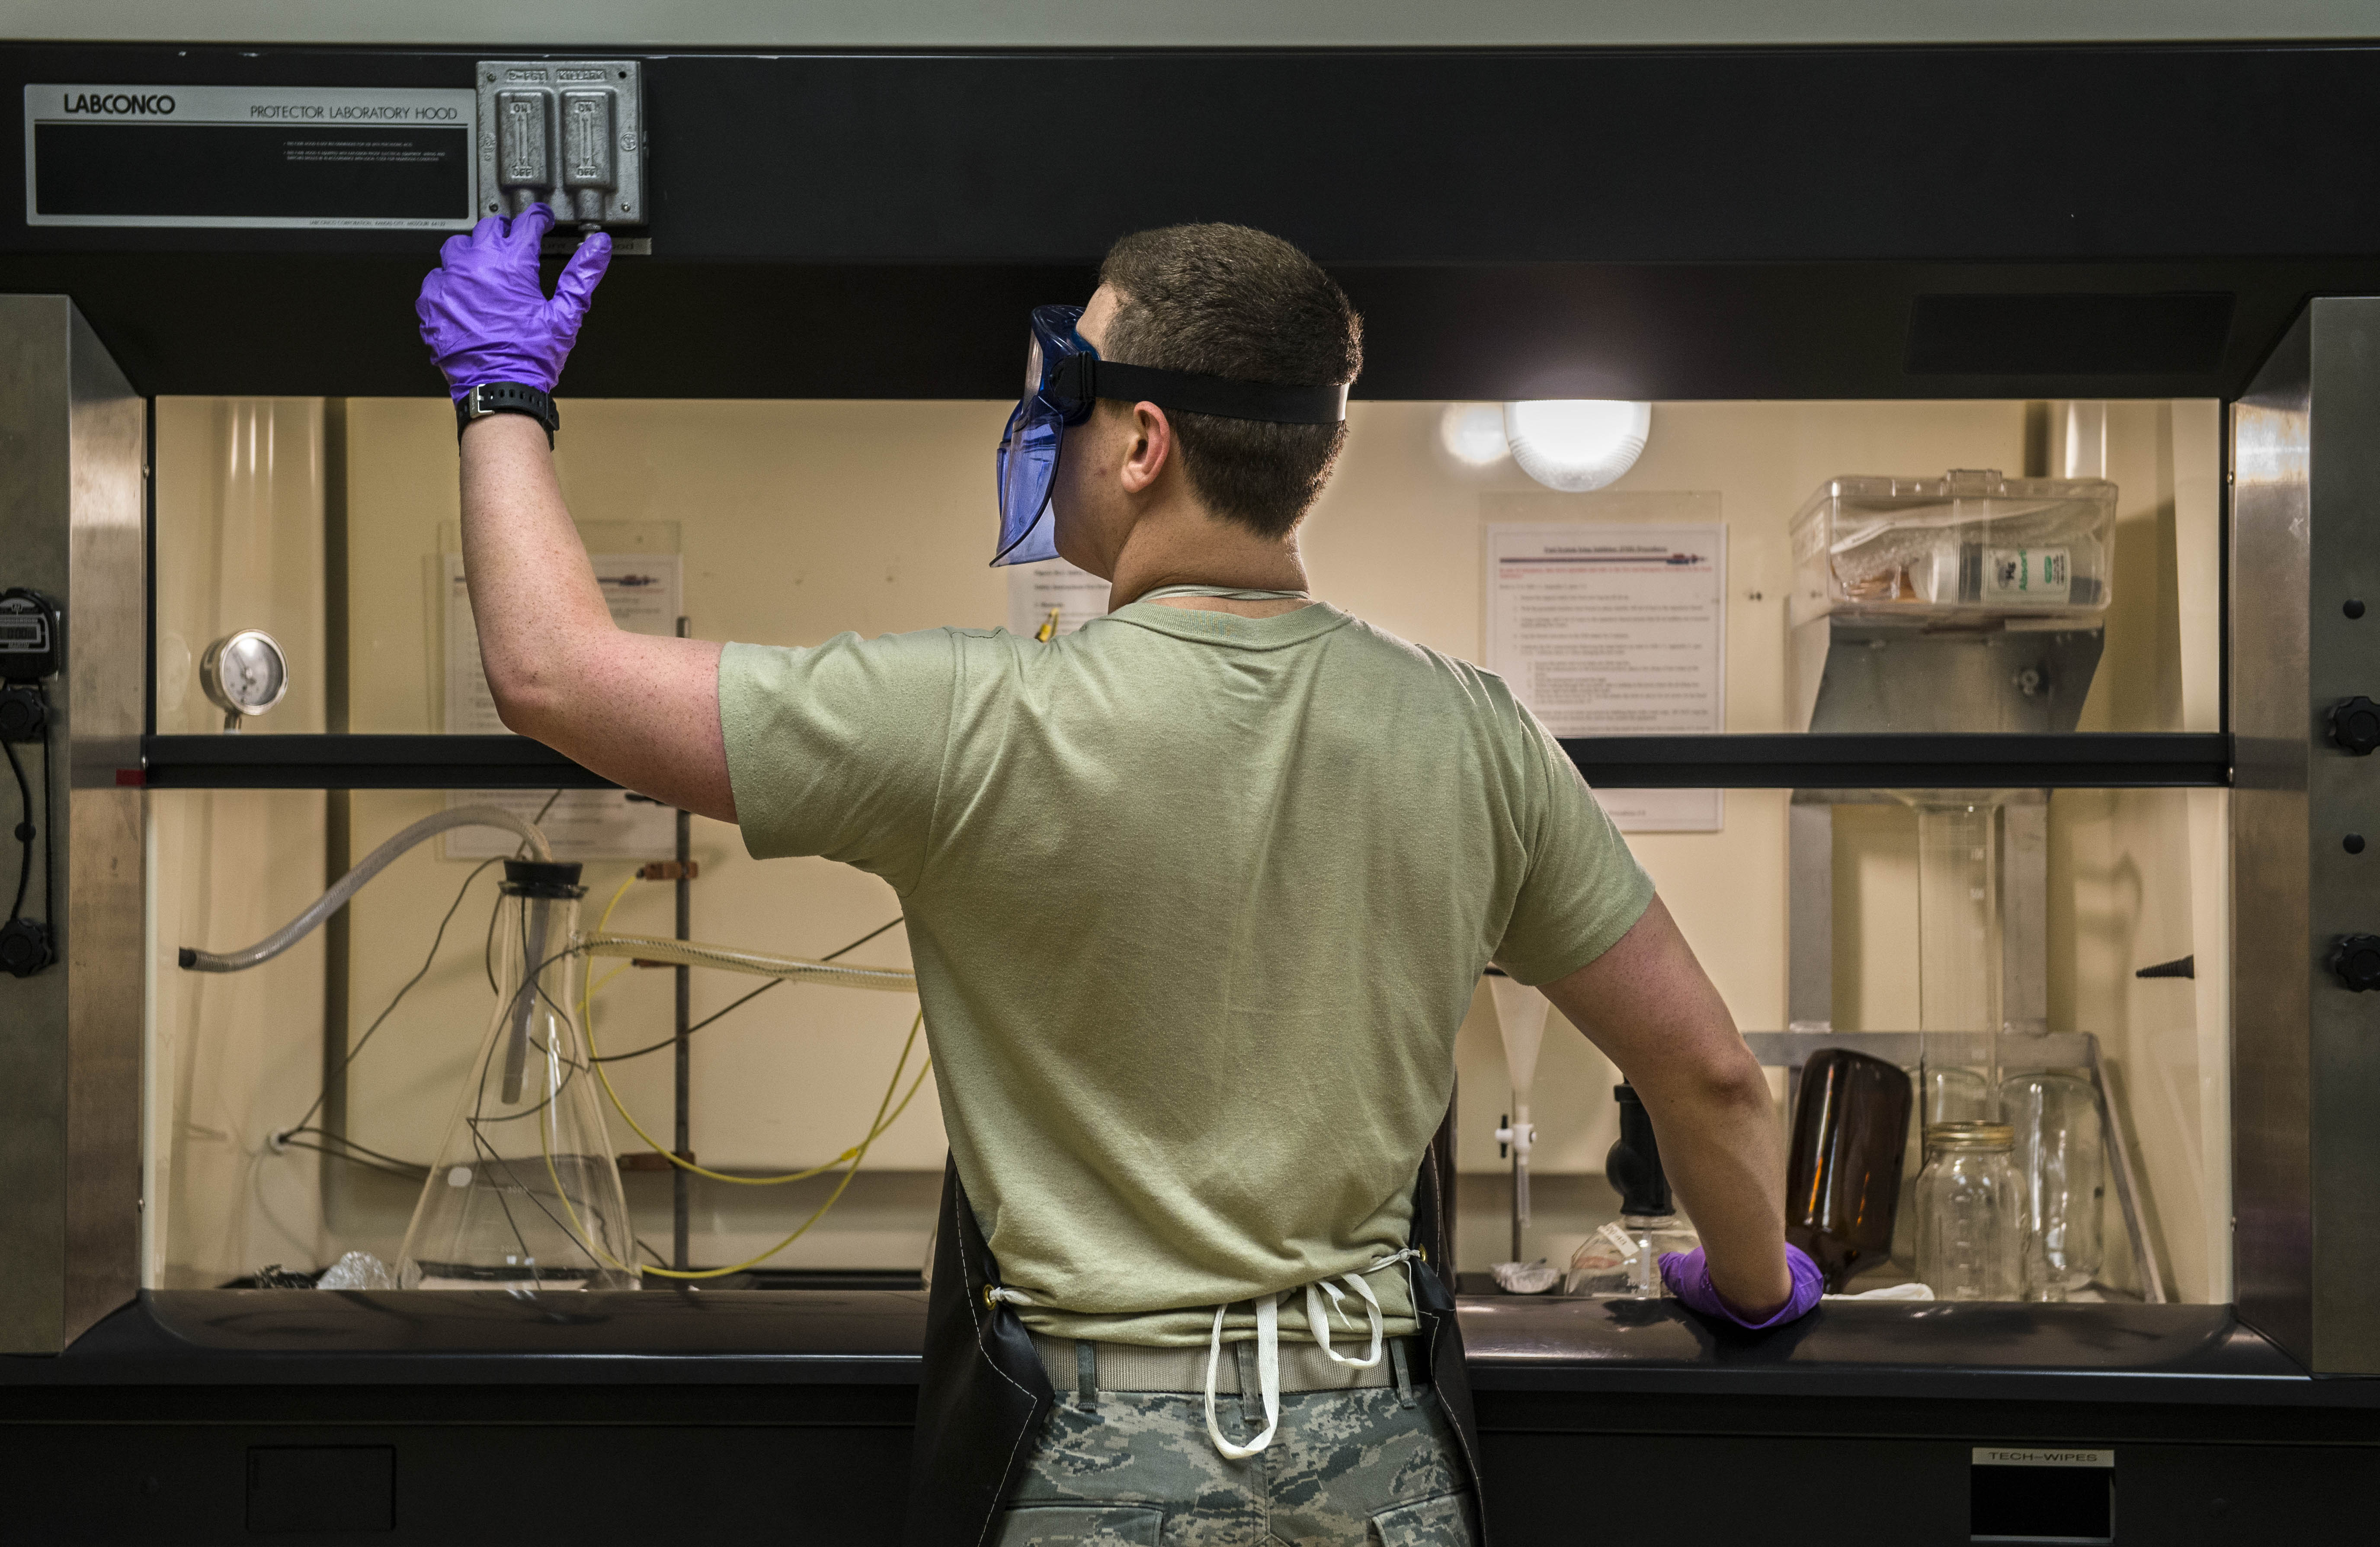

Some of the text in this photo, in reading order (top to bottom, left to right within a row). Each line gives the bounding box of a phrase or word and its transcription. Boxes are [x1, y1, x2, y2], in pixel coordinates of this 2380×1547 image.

[64, 93, 176, 115] LABCONCO
[514, 103, 528, 112] ON
[250, 105, 458, 120] PROTECTOR LABORATORY HOOD
[513, 167, 532, 177] OFF
[577, 167, 596, 176] OFF
[1989, 1452, 2098, 1462] TECH-WIPES
